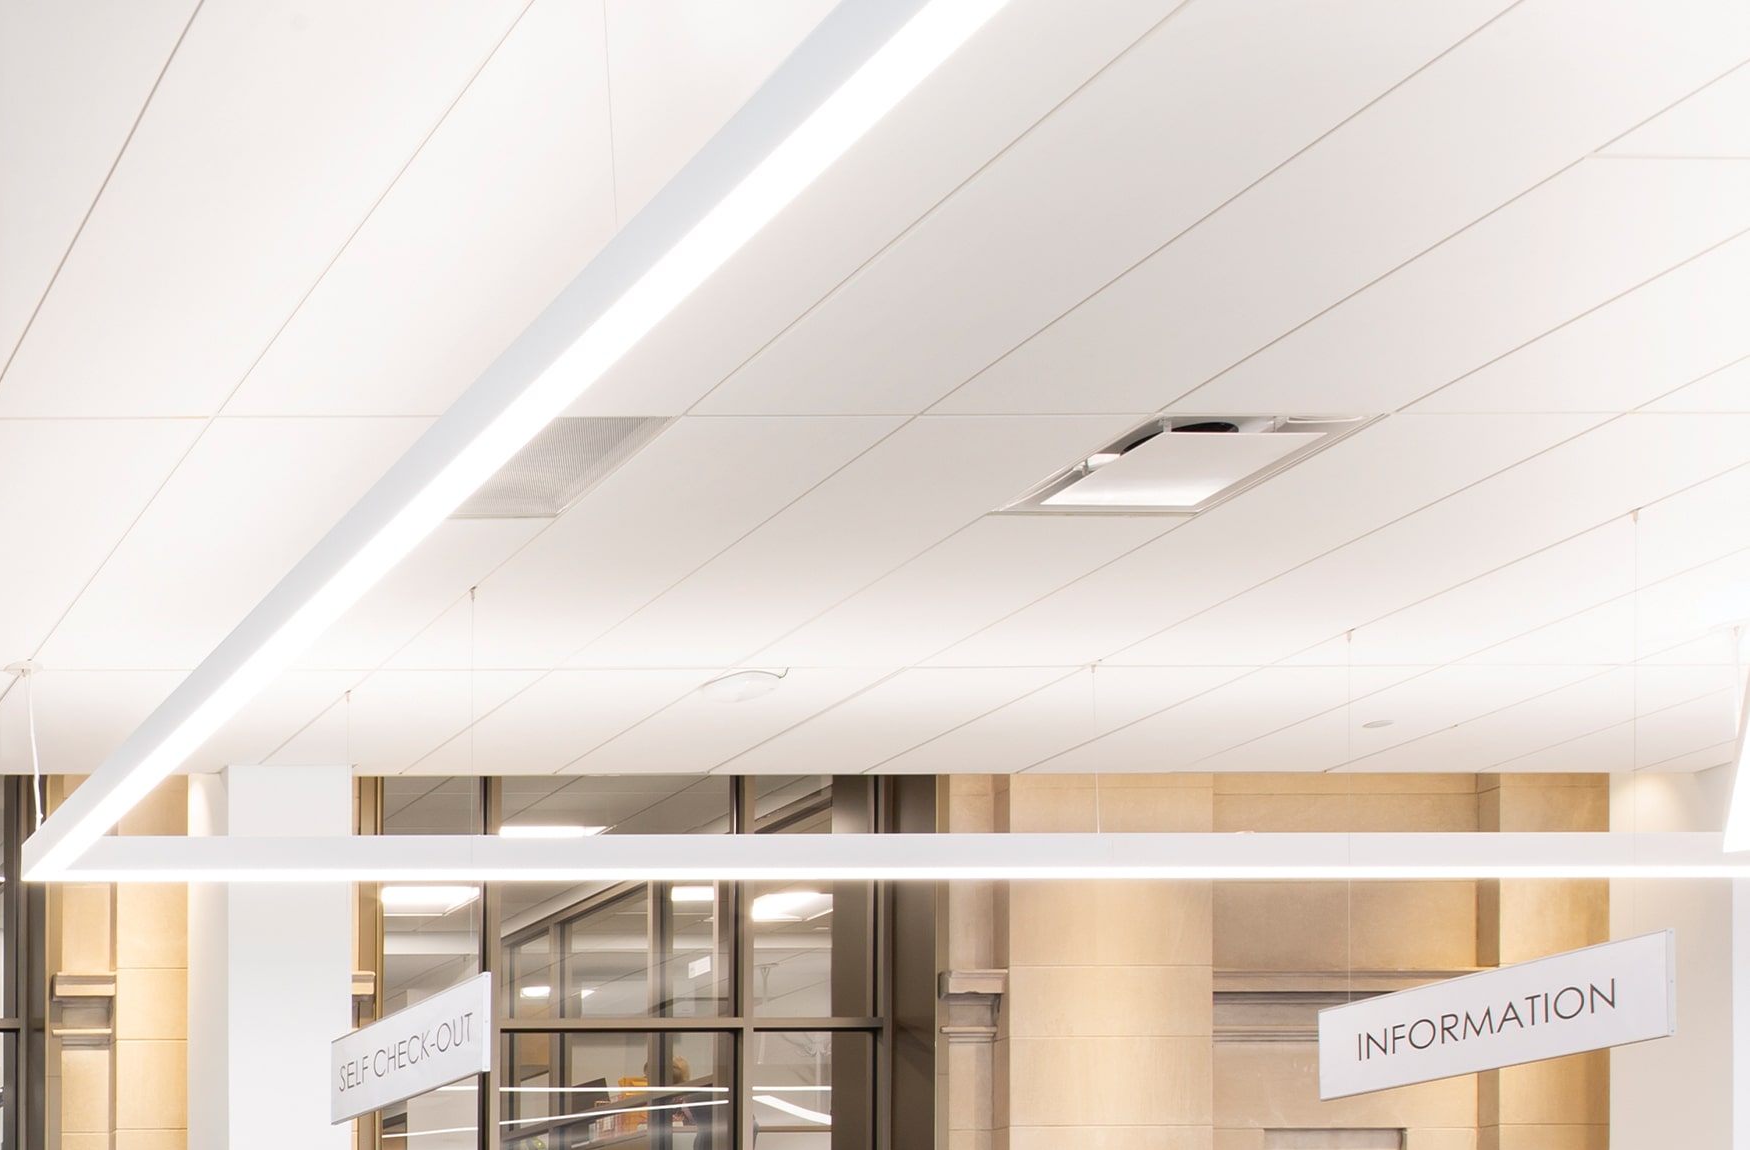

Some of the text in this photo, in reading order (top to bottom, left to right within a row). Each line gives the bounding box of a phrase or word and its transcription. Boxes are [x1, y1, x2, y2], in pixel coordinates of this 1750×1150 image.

[338, 1012, 473, 1093] SELF CHECK-OUT
[1357, 977, 1616, 1062] INFORMATION
